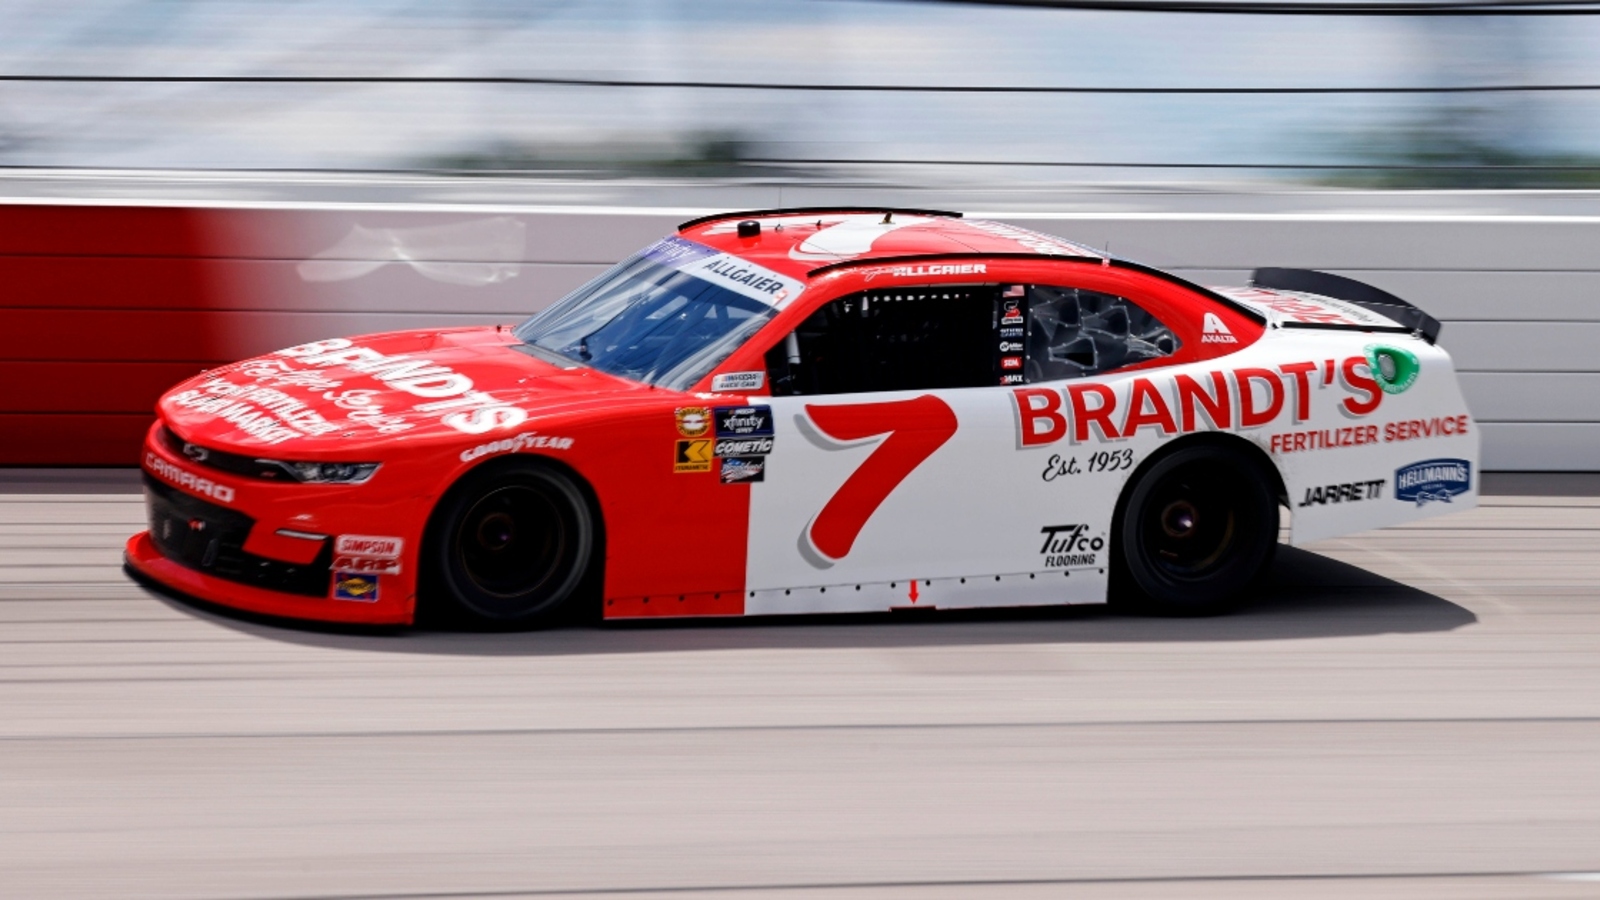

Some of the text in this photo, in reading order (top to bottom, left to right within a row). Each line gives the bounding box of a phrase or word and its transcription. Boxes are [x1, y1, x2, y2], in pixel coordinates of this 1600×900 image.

[702, 259, 785, 295] ALLGAIER
[893, 264, 987, 276] ALLGAIER
[1201, 334, 1239, 344] AXALTA
[1013, 355, 1384, 449] BRANDT'S
[723, 414, 764, 431] xfinity
[1270, 415, 1469, 453] FERTILIZER SERVICE
[715, 438, 772, 455] COMETIC
[145, 452, 236, 503] CAMARO
[1042, 448, 1134, 482] Est. 1953
[1398, 466, 1468, 490] HELLMANN'S
[797, 394, 958, 564] 7
[1298, 479, 1386, 507] JARRETT
[342, 540, 396, 553] SIMPSON
[1040, 523, 1104, 554] Tufco
[333, 557, 400, 572] ARP
[1045, 554, 1096, 568] FLOORING
